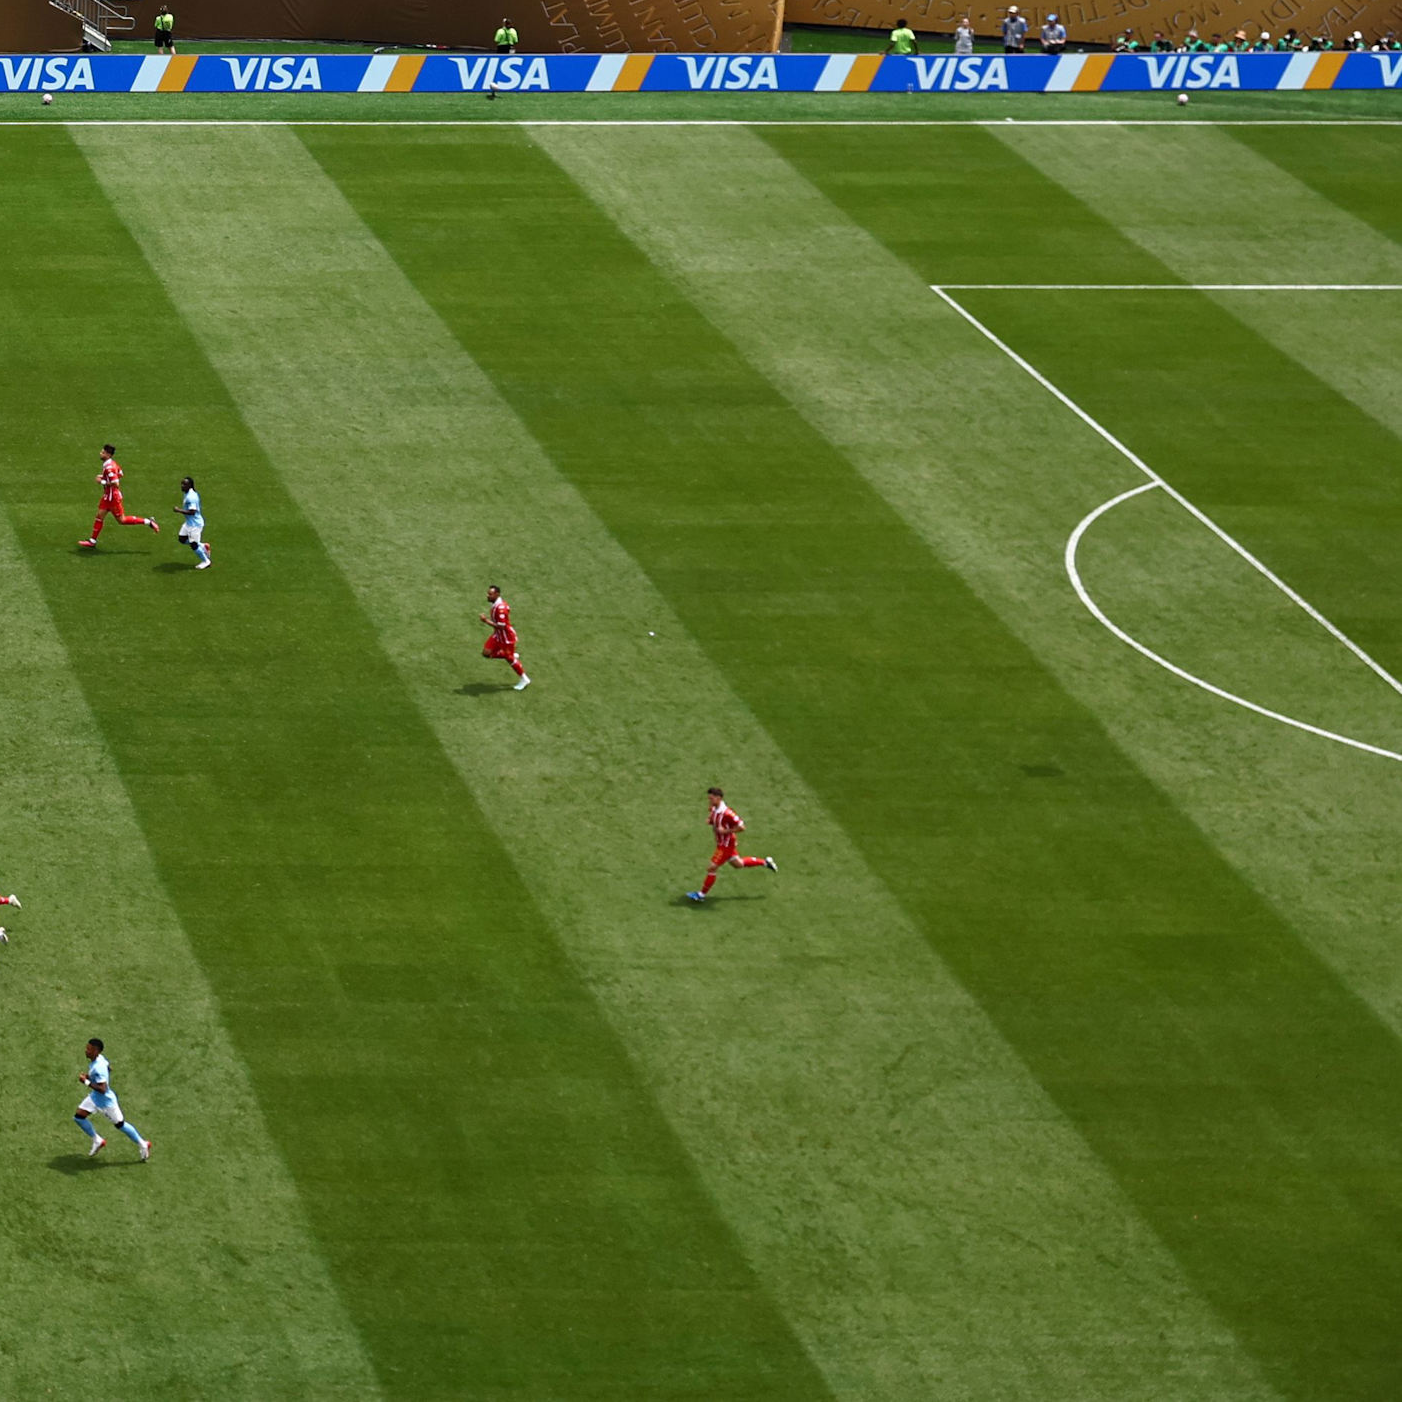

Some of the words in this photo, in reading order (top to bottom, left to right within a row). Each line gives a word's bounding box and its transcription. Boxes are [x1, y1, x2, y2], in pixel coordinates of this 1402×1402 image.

[220, 57, 322, 90] VISA
[448, 57, 550, 90] VISA
[677, 56, 778, 90] VISA
[907, 56, 1009, 90] VISA
[1138, 55, 1240, 89] VISA
